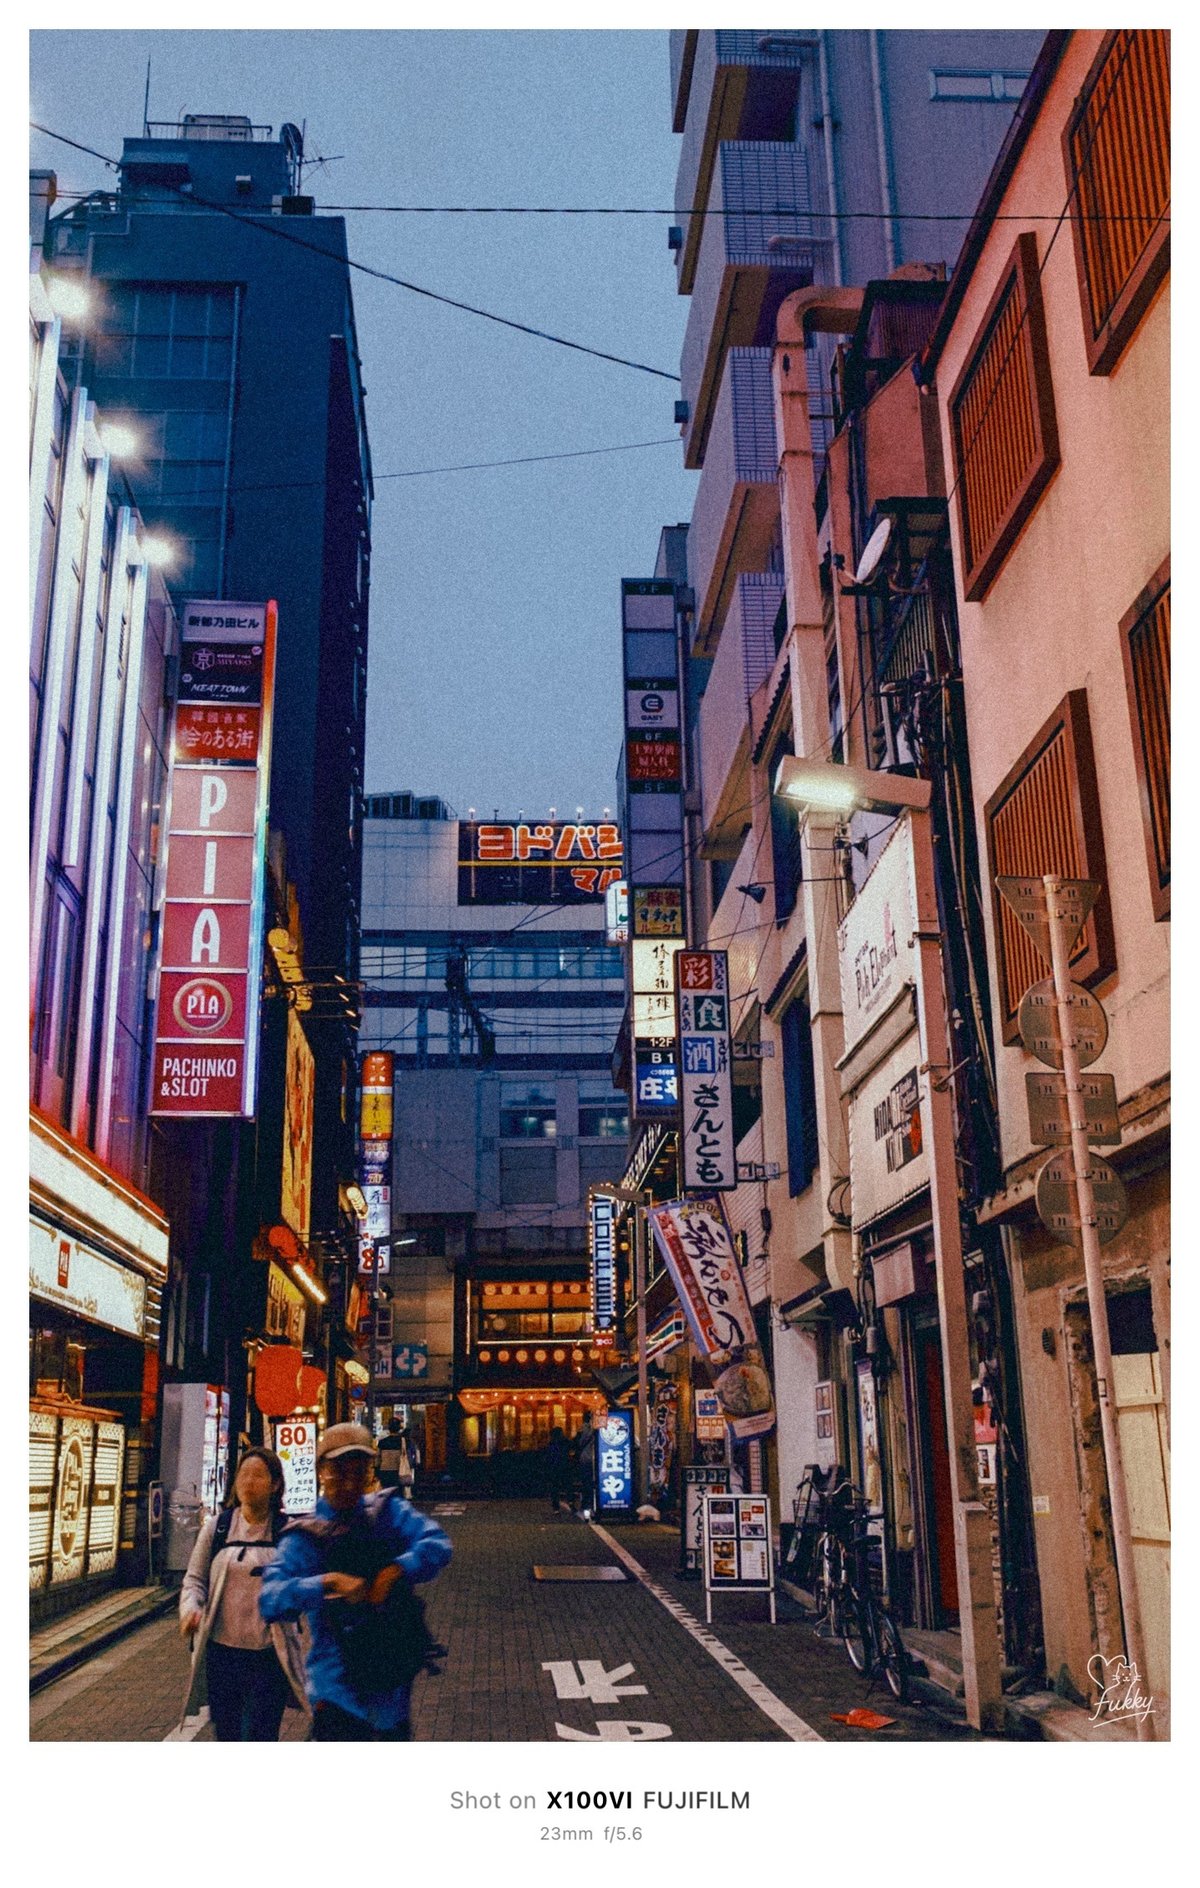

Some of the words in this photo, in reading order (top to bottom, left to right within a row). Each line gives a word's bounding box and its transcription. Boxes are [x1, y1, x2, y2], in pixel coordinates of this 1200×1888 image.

[217, 658, 252, 666] MIYAKO
[191, 684, 218, 693] MEAT
[220, 685, 249, 694] TOWN
[645, 681, 659, 689] 7F
[645, 732, 662, 741] 6F
[684, 957, 709, 987] 彩
[186, 995, 219, 1014] PIA
[697, 998, 722, 1029] 食
[686, 1040, 712, 1072] 酒
[162, 1057, 237, 1077] PACHINKO
[161, 1078, 209, 1097] &SLOT
[692, 1083, 725, 1186] さんとも
[595, 1204, 612, 1312] COFFEE
[280, 1426, 306, 1446] 80
[291, 1457, 314, 1467] レモン
[295, 1467, 315, 1475] サワー
[601, 1449, 625, 1500] 庄や
[287, 1486, 315, 1494] イボール
[286, 1498, 315, 1506] イスサワー
